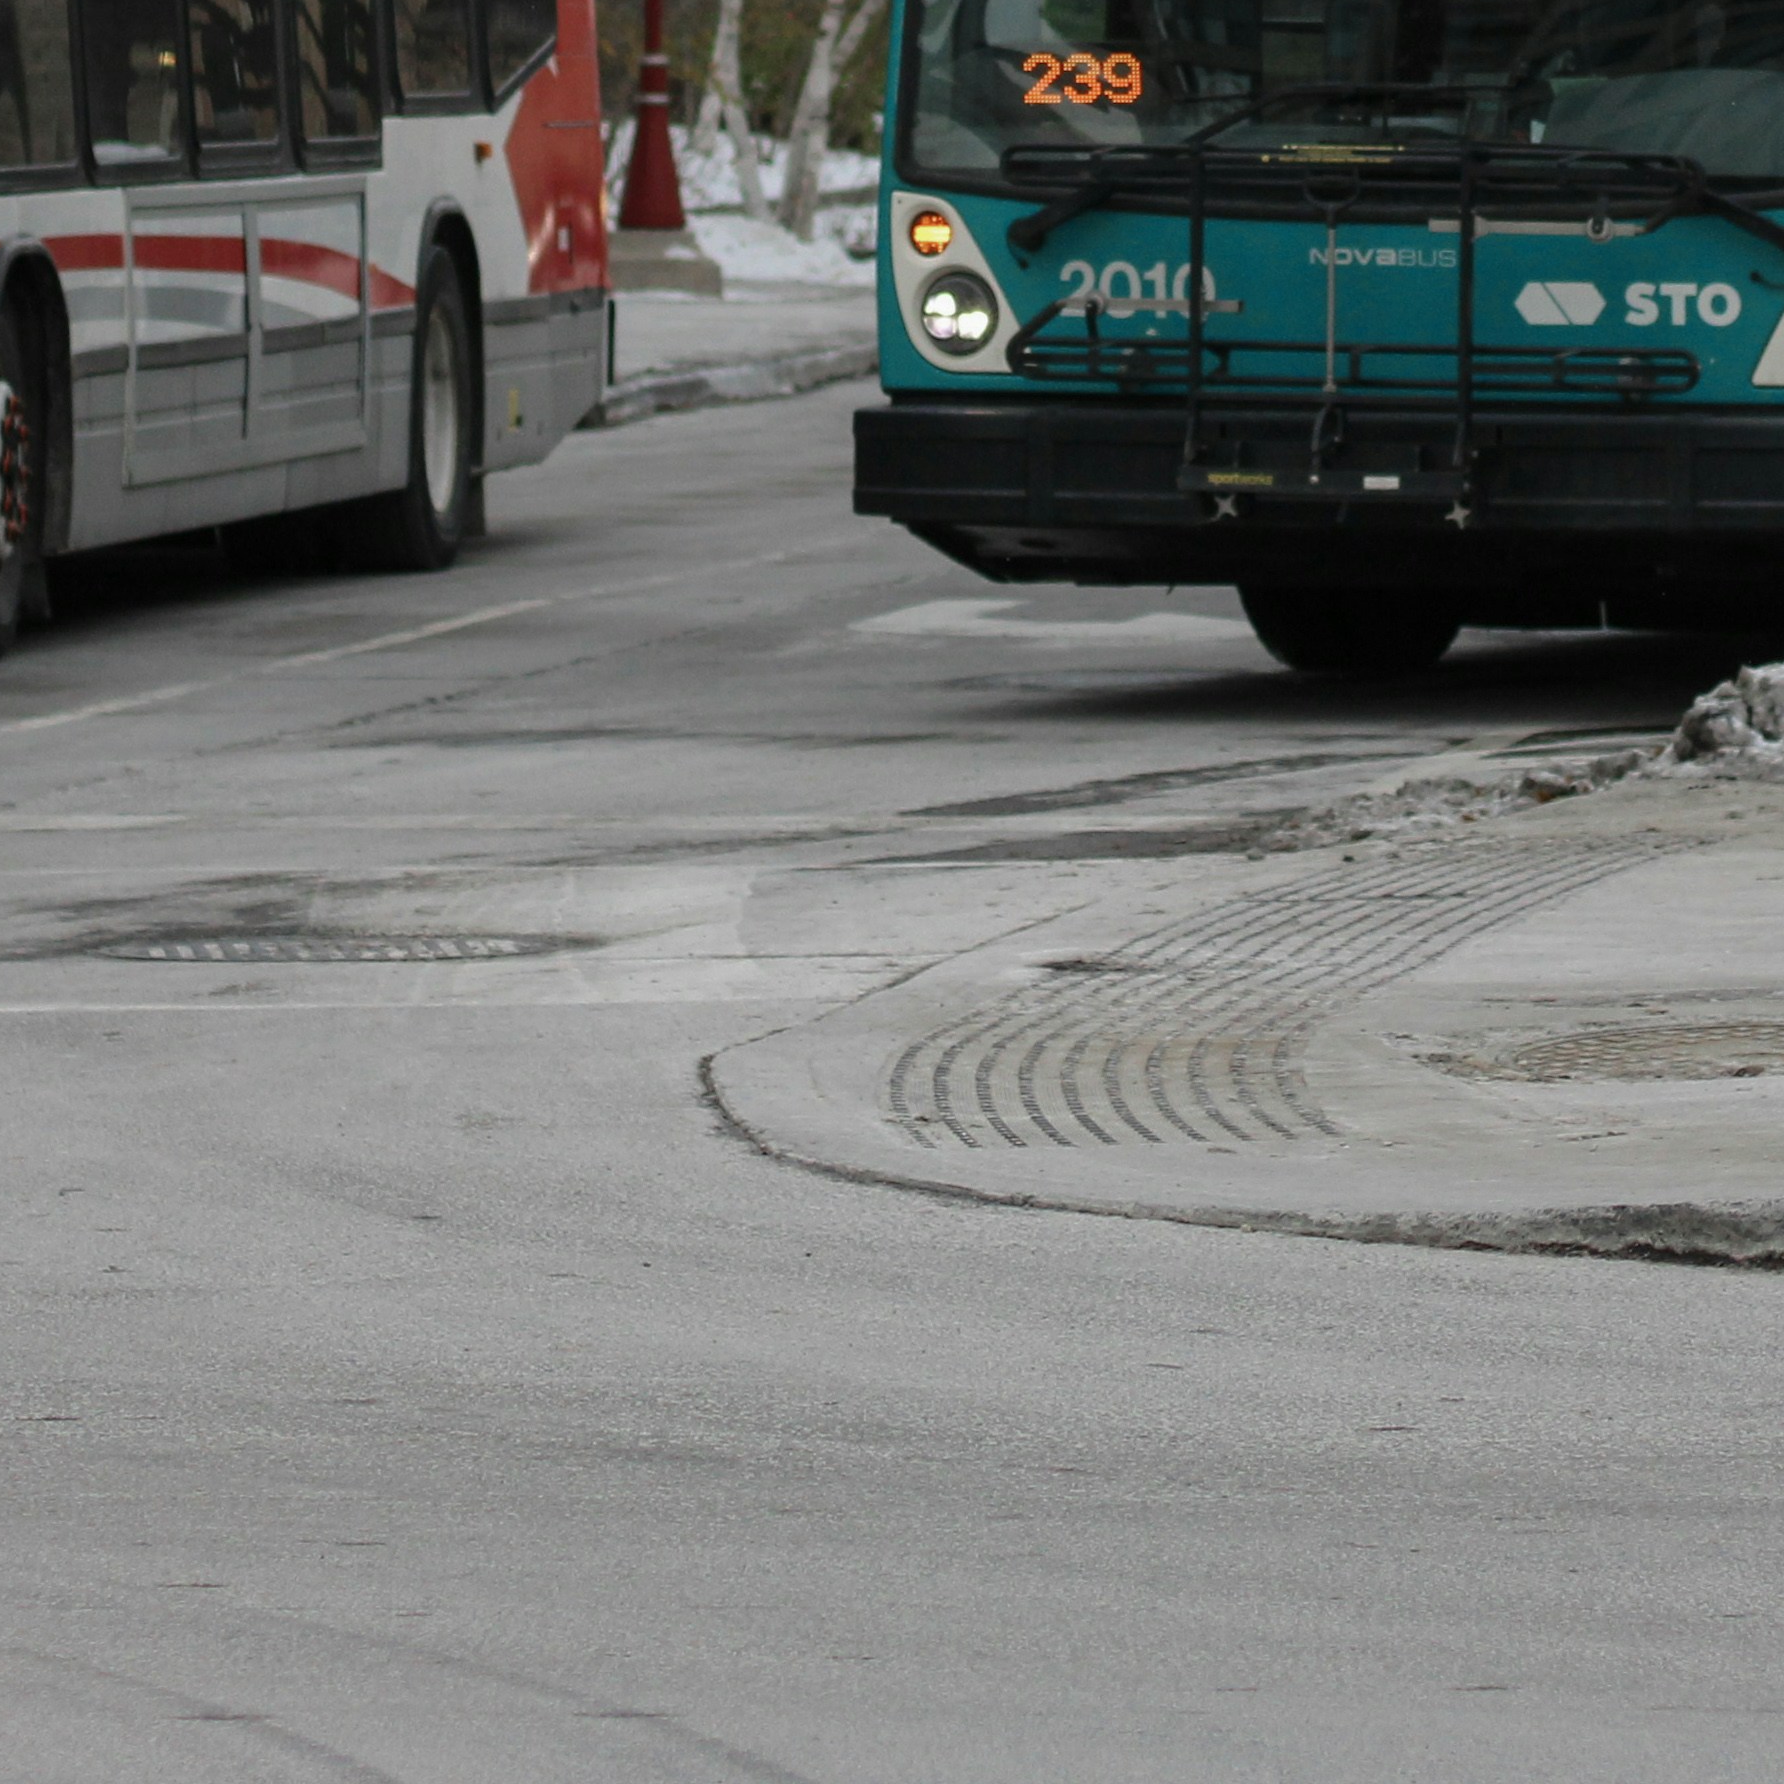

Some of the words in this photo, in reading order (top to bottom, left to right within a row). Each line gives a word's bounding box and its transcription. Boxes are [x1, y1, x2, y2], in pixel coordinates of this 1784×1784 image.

[1022, 52, 1142, 105] 239
[1059, 260, 1216, 320] 2010
[1624, 282, 1742, 326] STO
